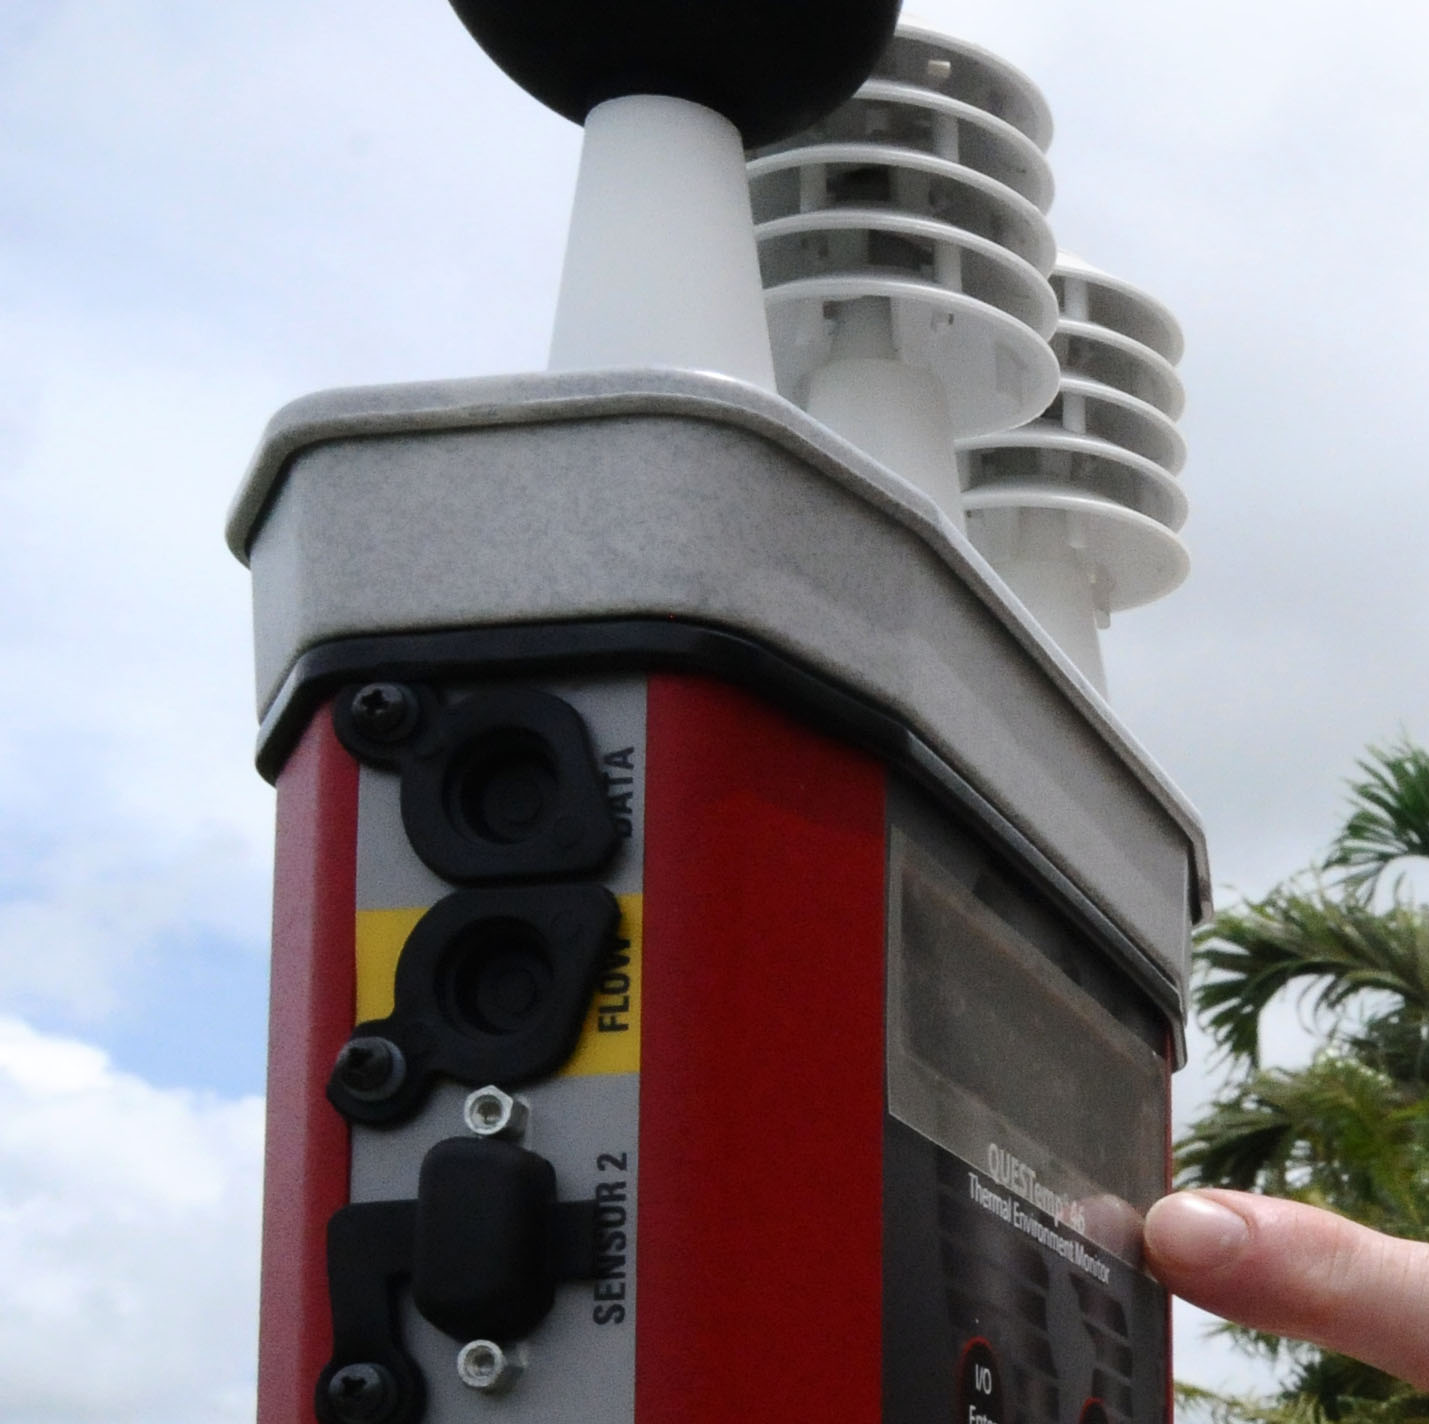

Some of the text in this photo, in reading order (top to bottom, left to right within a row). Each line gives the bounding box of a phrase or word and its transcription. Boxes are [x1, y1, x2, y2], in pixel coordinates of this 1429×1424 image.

[598, 938, 631, 1032] FLOW
[593, 1152, 627, 1325] SENSOR 2
[968, 1172, 1110, 1285] Thermal Environment Monitor
